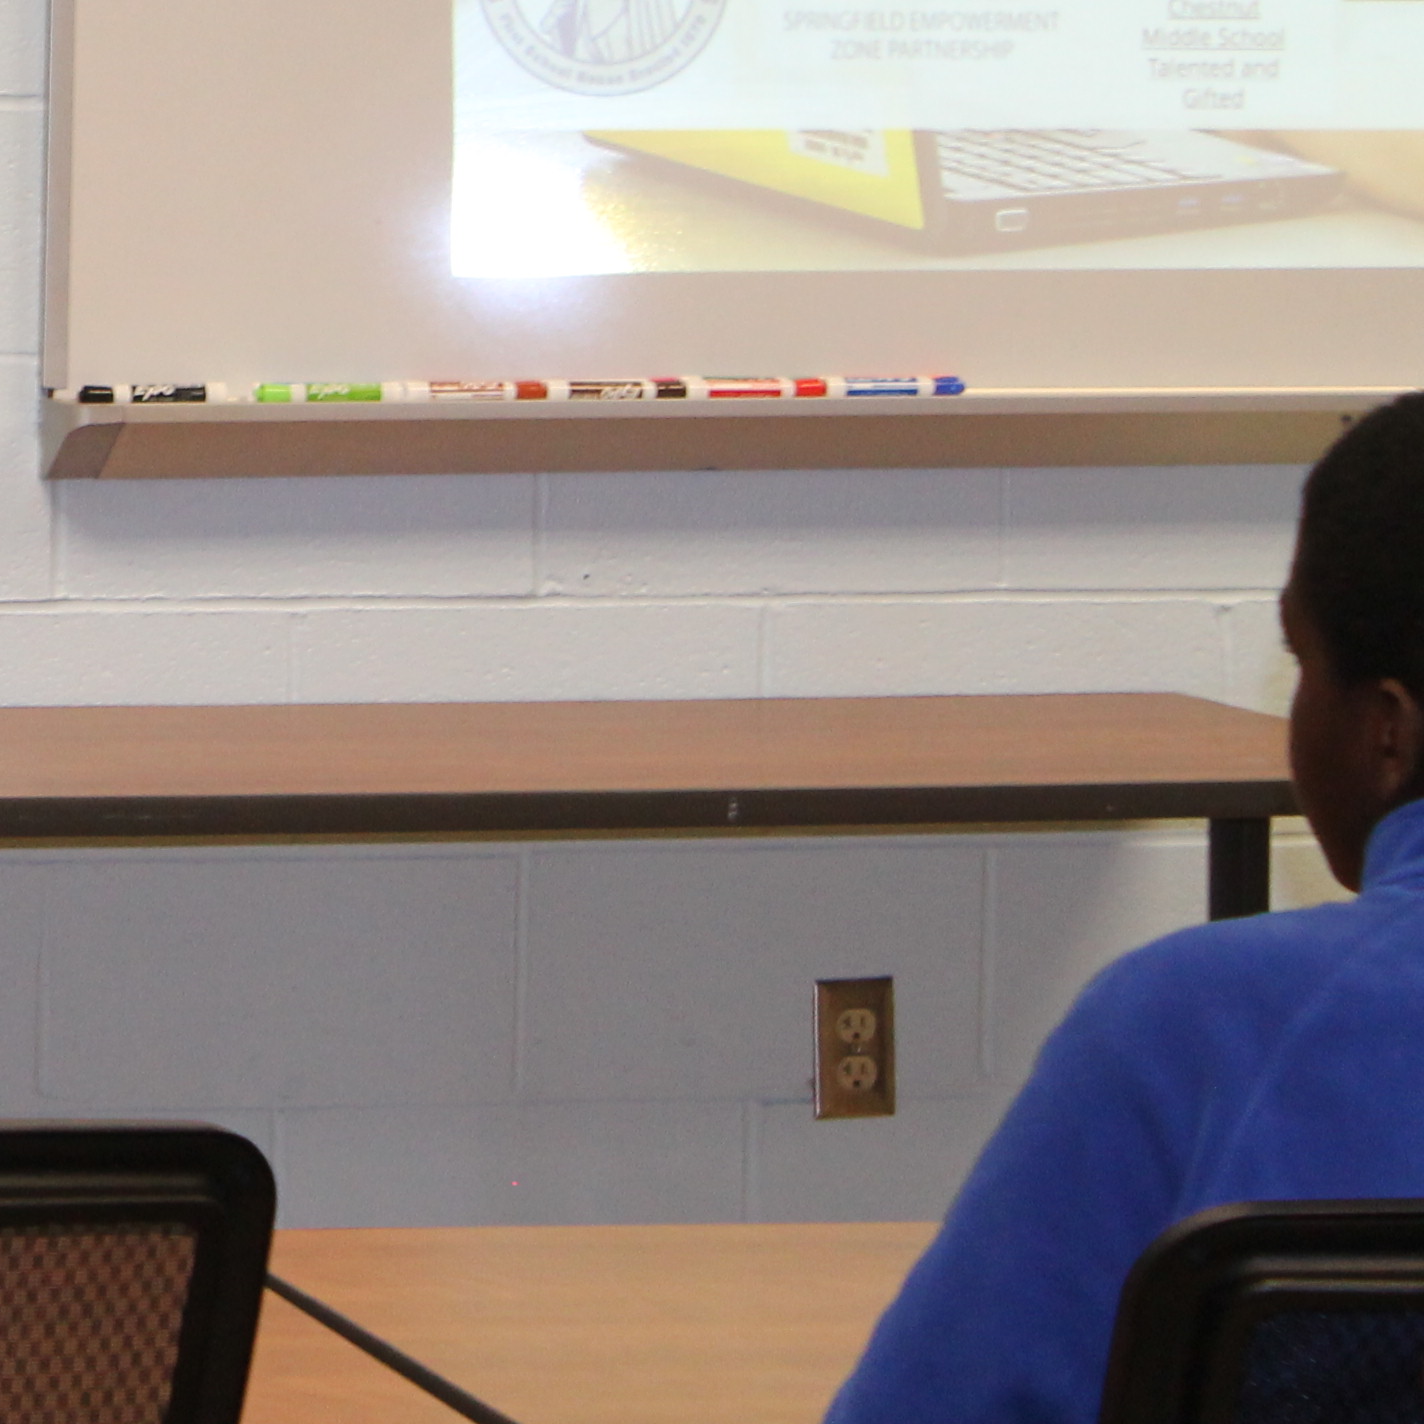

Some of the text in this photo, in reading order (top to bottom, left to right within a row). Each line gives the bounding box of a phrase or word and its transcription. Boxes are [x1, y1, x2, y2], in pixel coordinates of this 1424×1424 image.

[782, 10, 1060, 33] SPRINGFIELD EMPOWERMENT
[1141, 26, 1285, 49] Middle School
[830, 39, 1015, 61] ZONE PARTNERSHIP
[1148, 57, 1281, 79] Talented and
[1182, 87, 1246, 110] Gifted
